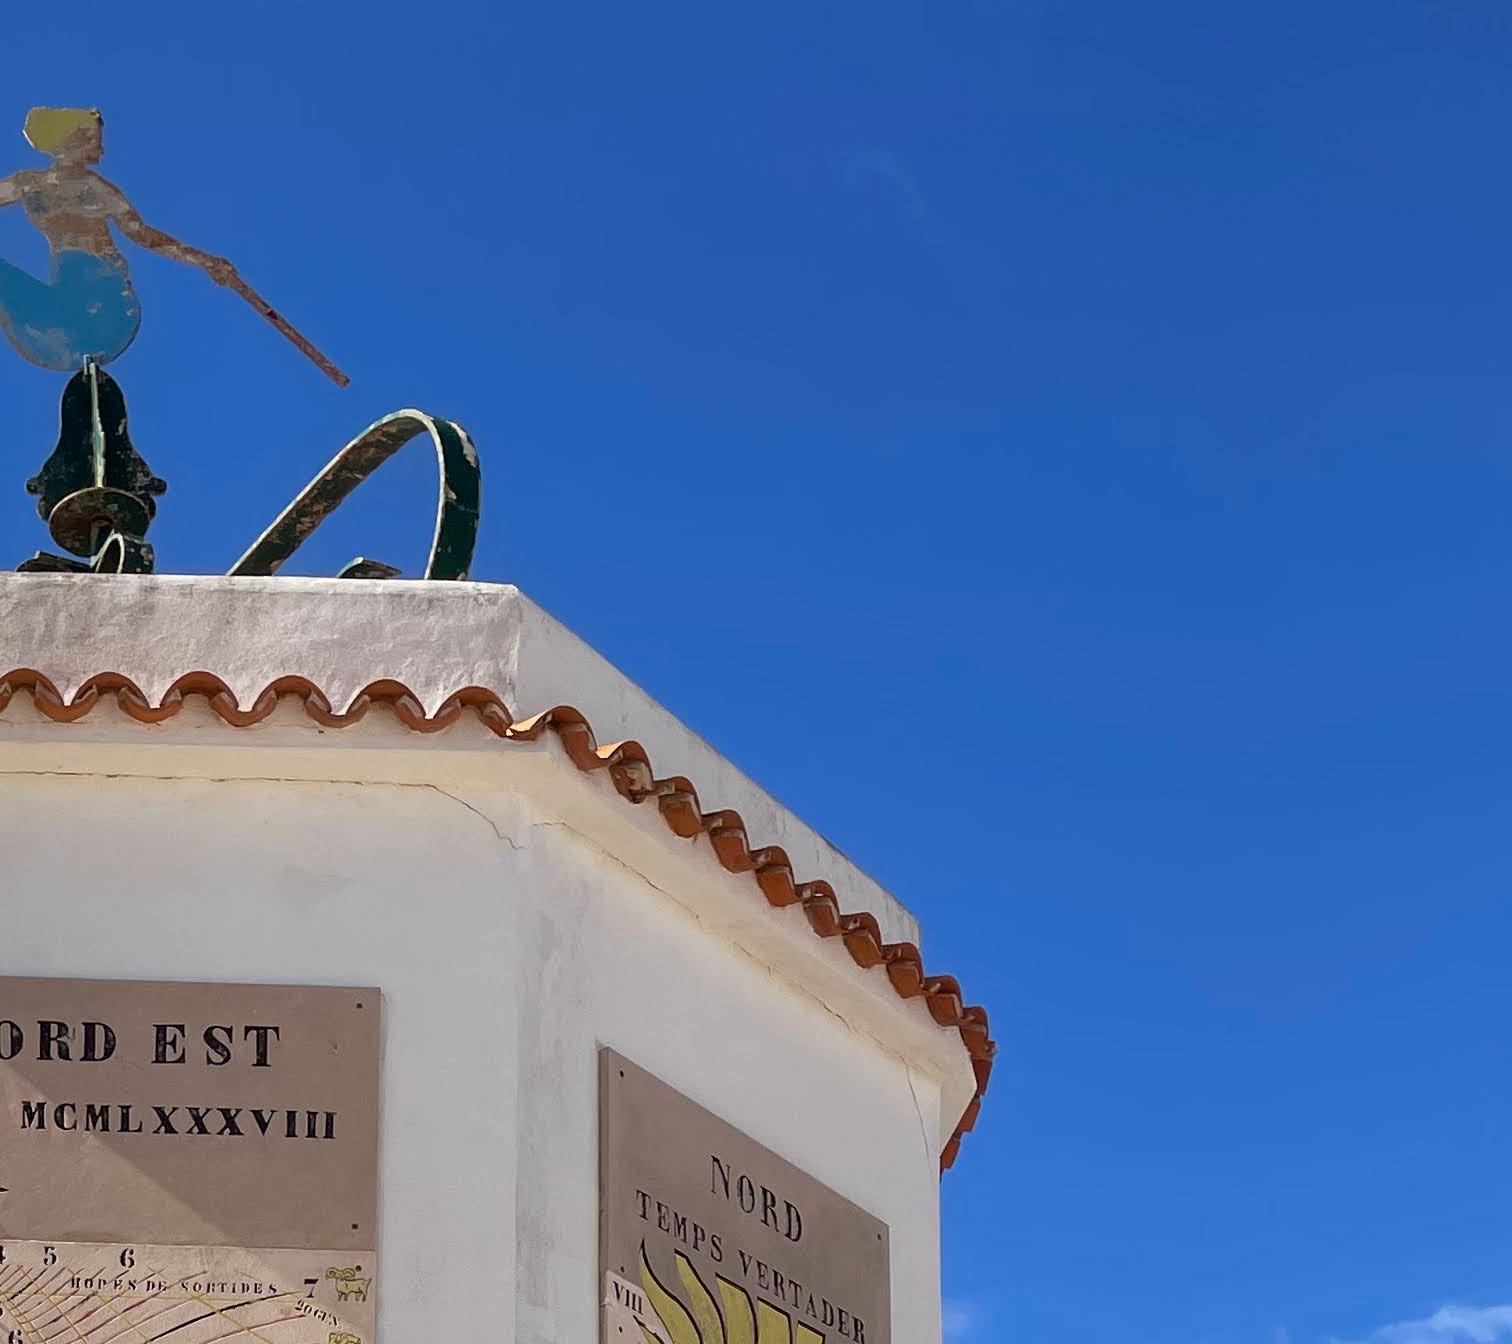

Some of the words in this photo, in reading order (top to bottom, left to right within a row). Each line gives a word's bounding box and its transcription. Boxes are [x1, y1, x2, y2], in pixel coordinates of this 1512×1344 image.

[151, 1024, 281, 1067] EST
[20, 1100, 337, 1139] MCMLXXXVIII
[710, 1155, 803, 1243] NORD
[636, 1190, 724, 1262] TEMPS
[44, 1246, 57, 1266] 5
[120, 1248, 135, 1268] 6
[303, 1278, 319, 1298] 7
[613, 1281, 644, 1315] VIII
